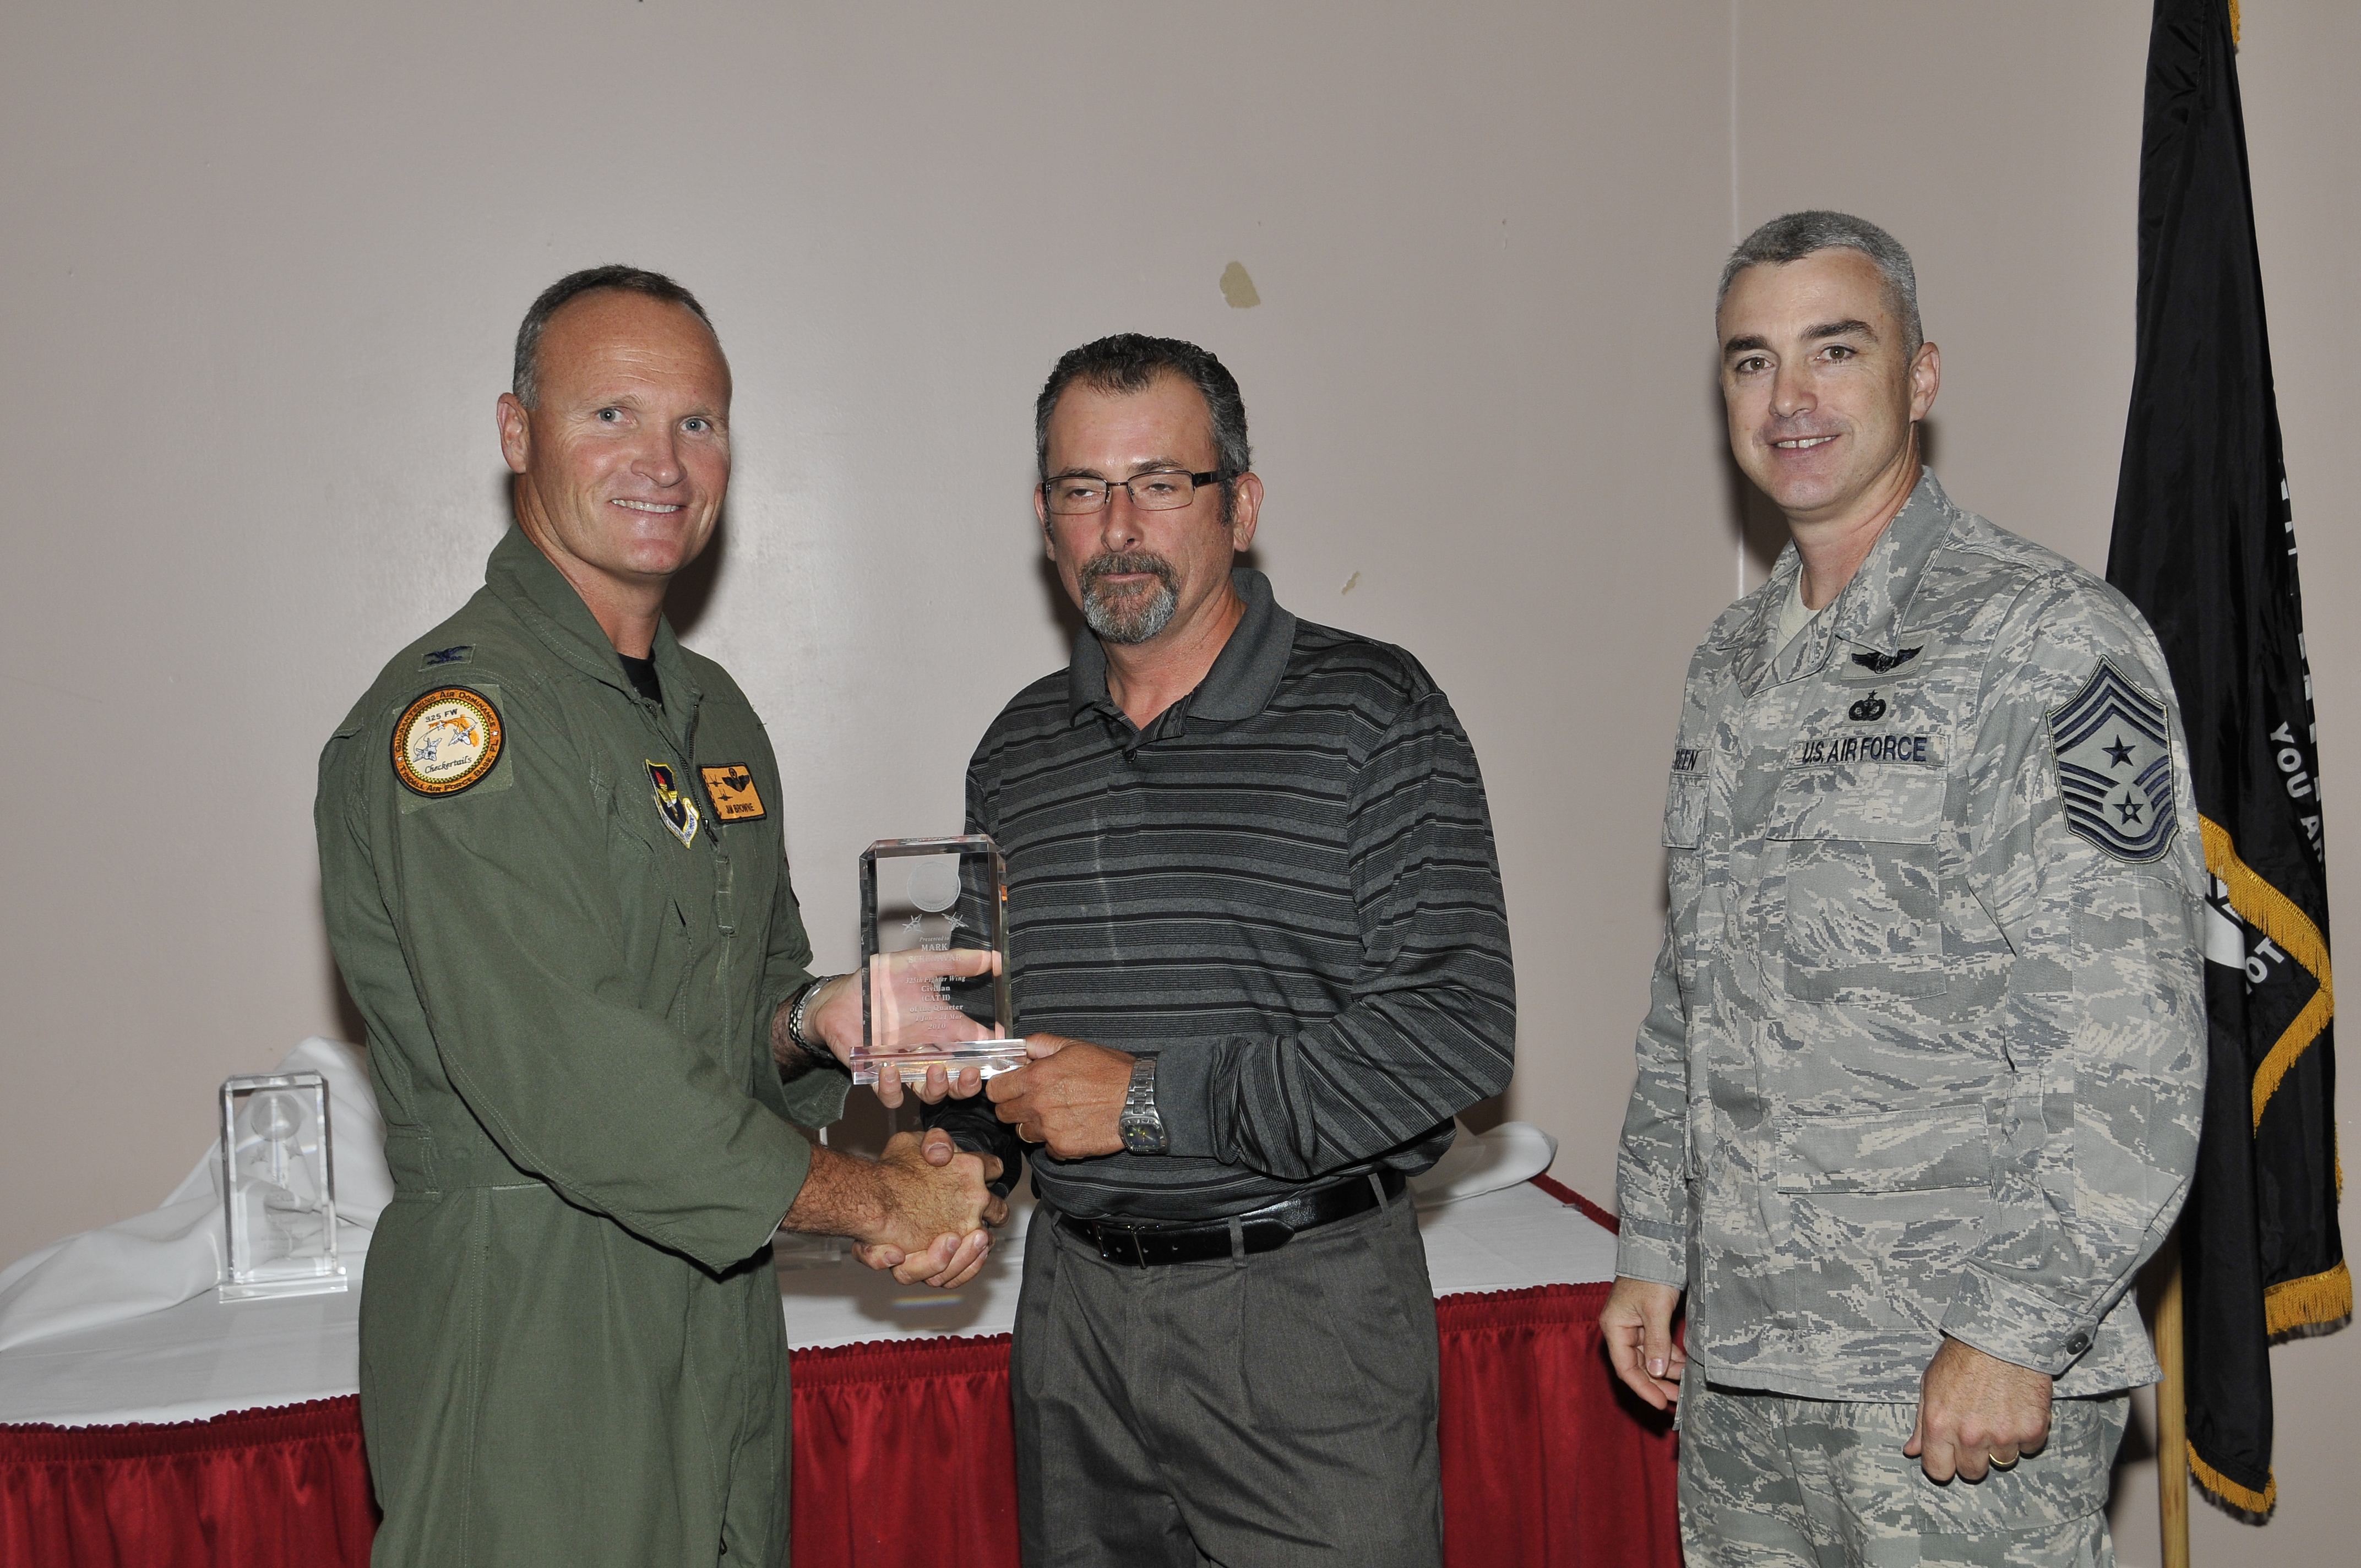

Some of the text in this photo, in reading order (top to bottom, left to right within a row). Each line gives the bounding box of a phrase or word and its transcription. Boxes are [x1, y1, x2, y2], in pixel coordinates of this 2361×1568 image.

[444, 709, 458, 717] FW
[459, 692, 496, 727] DOMINANCE
[1827, 738, 1857, 763] AIR
[1860, 735, 1927, 761] FORCE
[2270, 721, 2312, 798] YOU
[425, 756, 472, 774] Checkertails
[444, 777, 472, 791] FORCE
[489, 739, 499, 752] FL
[921, 943, 948, 951] MARK
[924, 975, 948, 984] Fighter
[2245, 937, 2284, 995] OT
